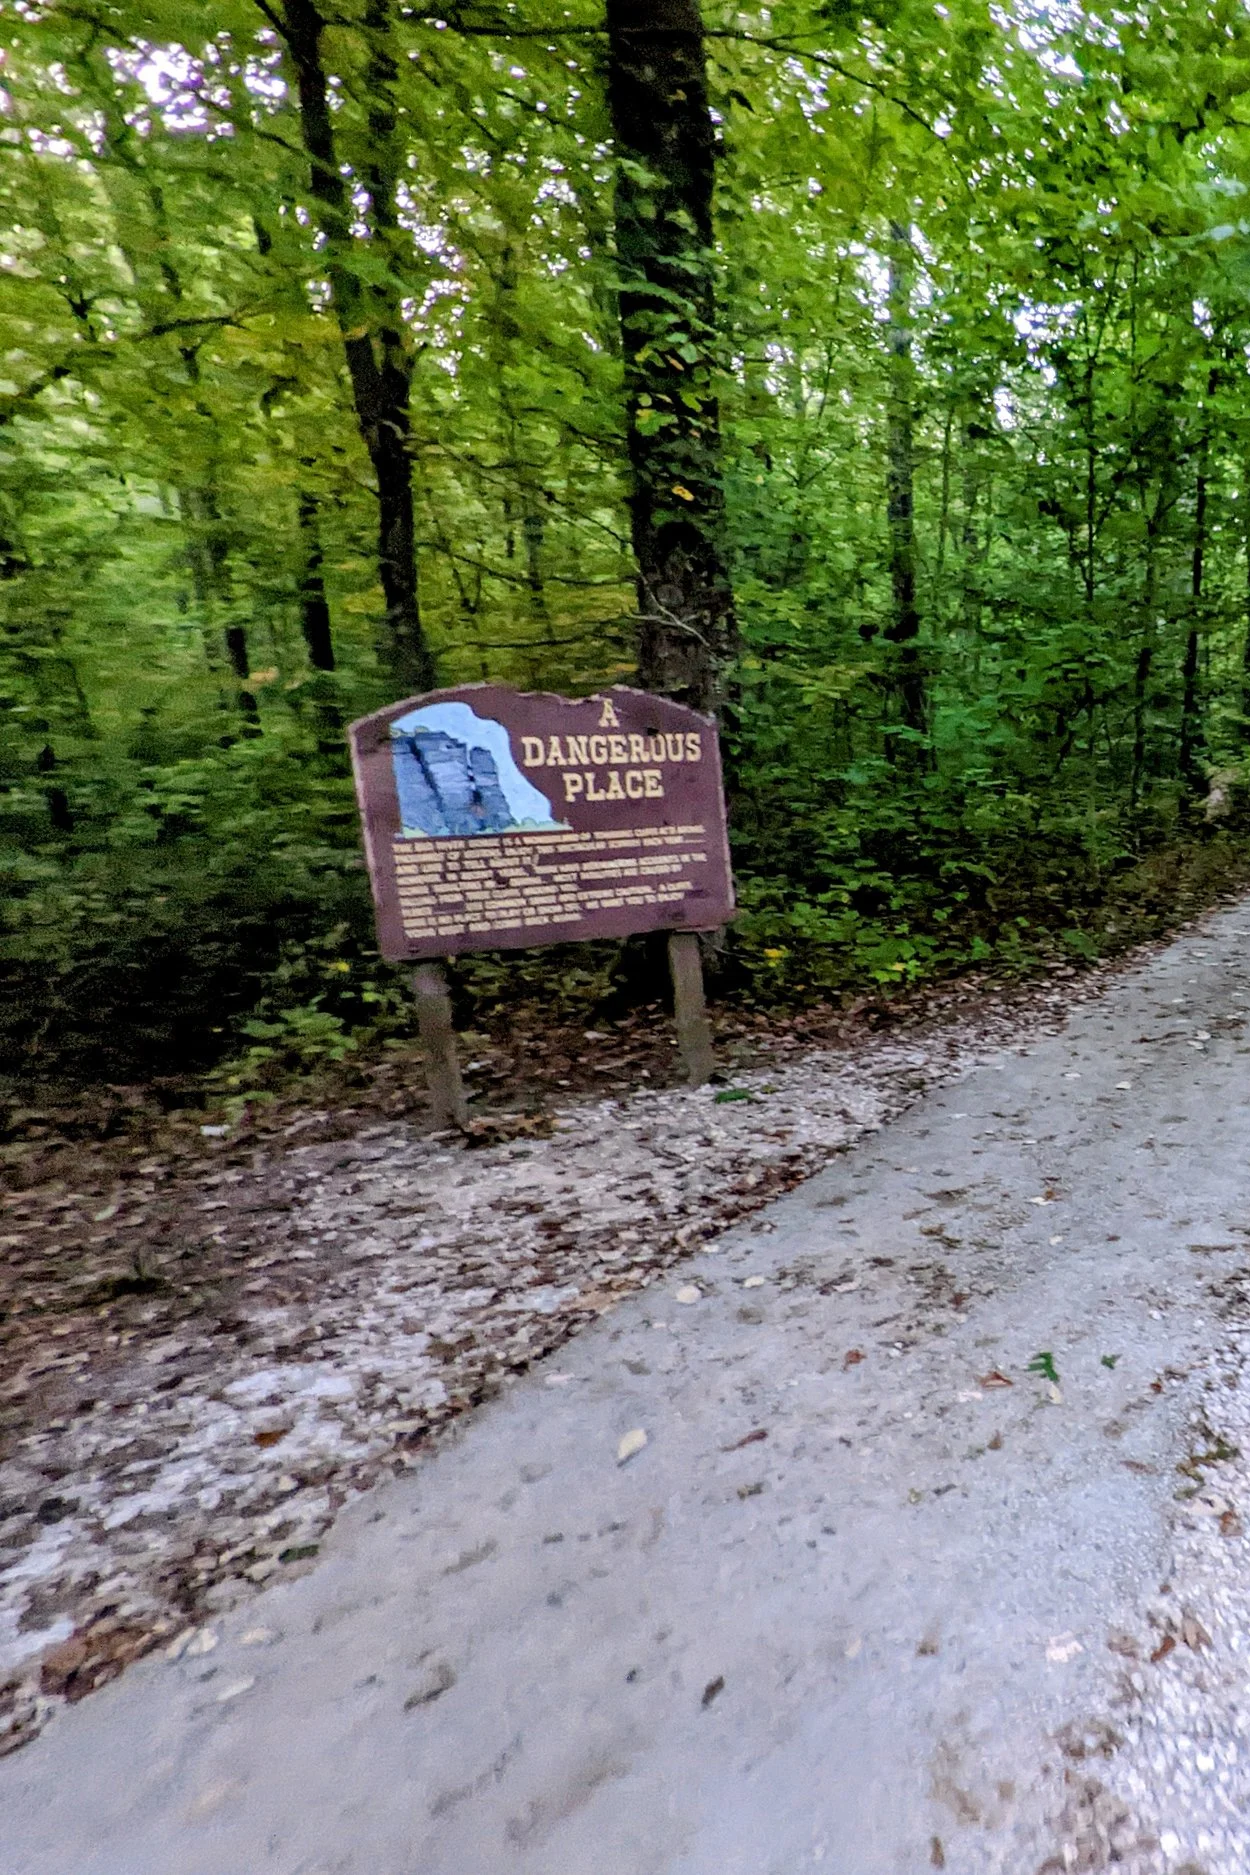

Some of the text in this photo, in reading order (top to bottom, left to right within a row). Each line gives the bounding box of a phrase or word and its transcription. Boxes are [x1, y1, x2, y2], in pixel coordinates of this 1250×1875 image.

[598, 698, 620, 728] A
[521, 732, 702, 767] DANGEROUS
[562, 769, 665, 802] PLACE
